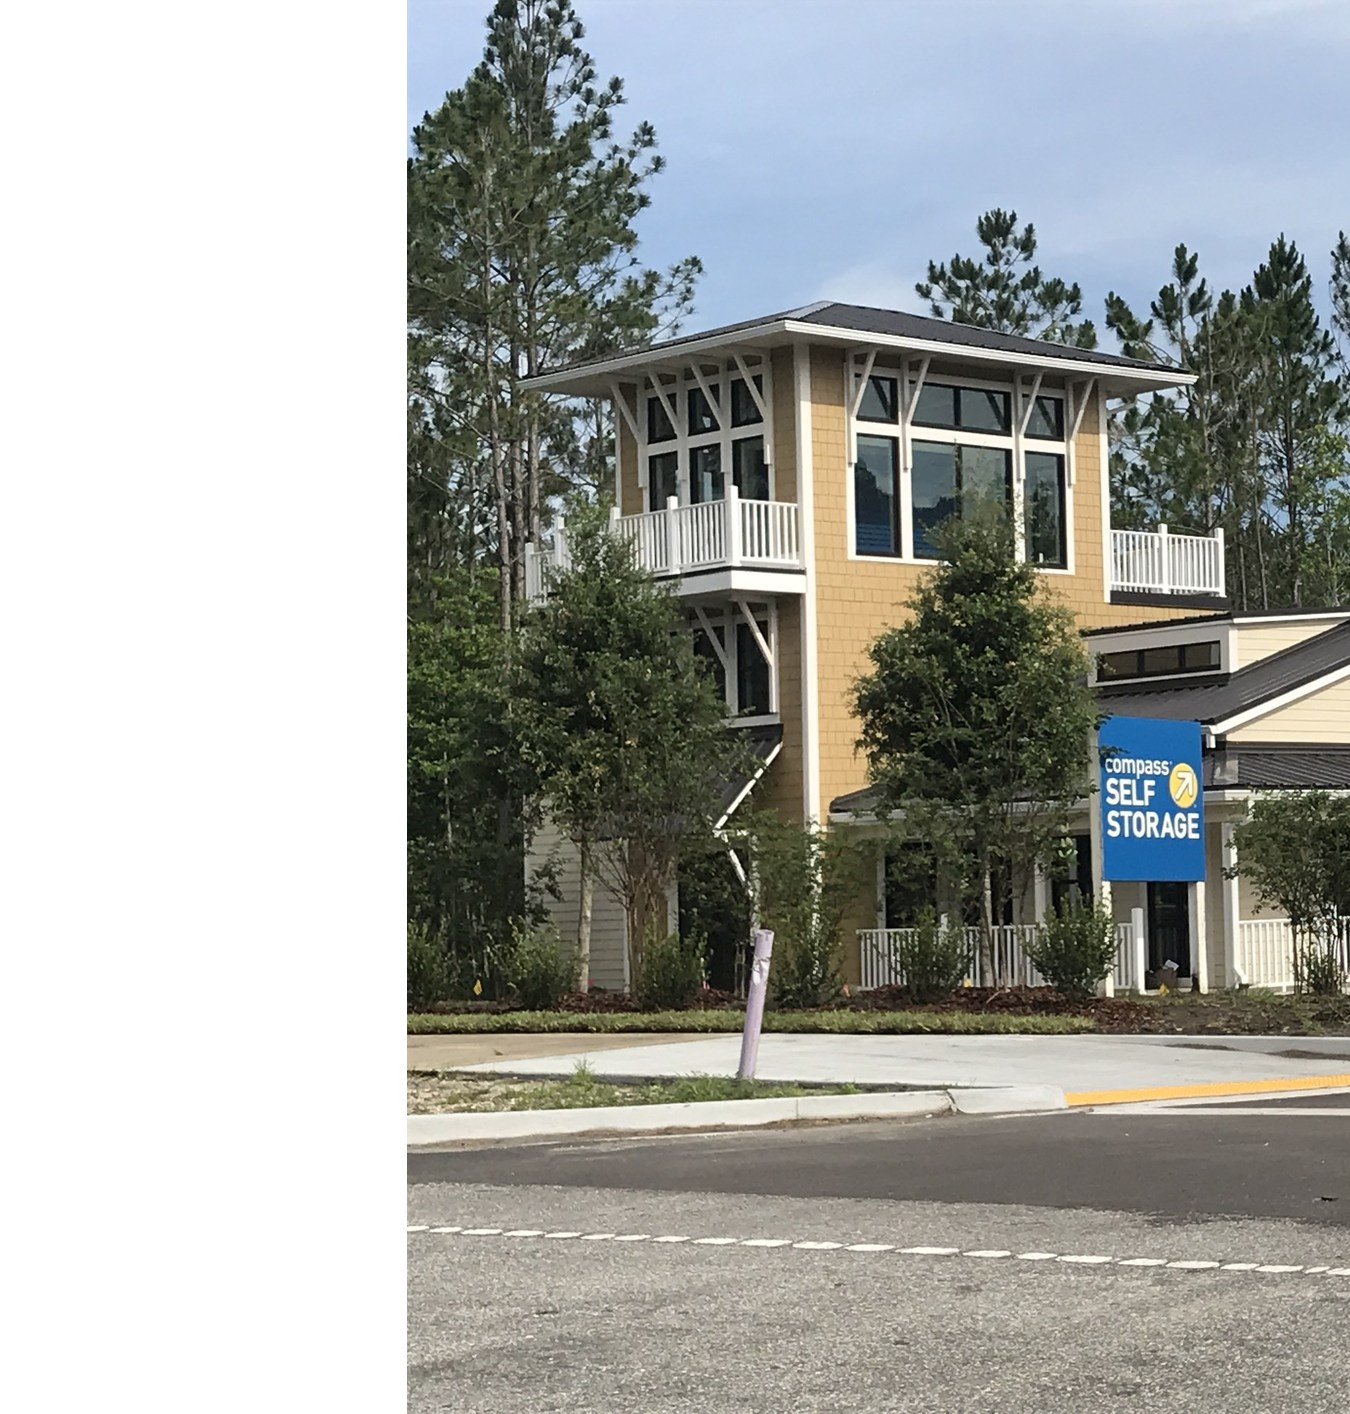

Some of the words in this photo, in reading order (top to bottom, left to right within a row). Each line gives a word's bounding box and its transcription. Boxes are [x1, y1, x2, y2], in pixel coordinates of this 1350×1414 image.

[1105, 758, 1170, 779] compass
[1106, 778, 1155, 806] SELF
[1107, 810, 1200, 839] STORAGE
